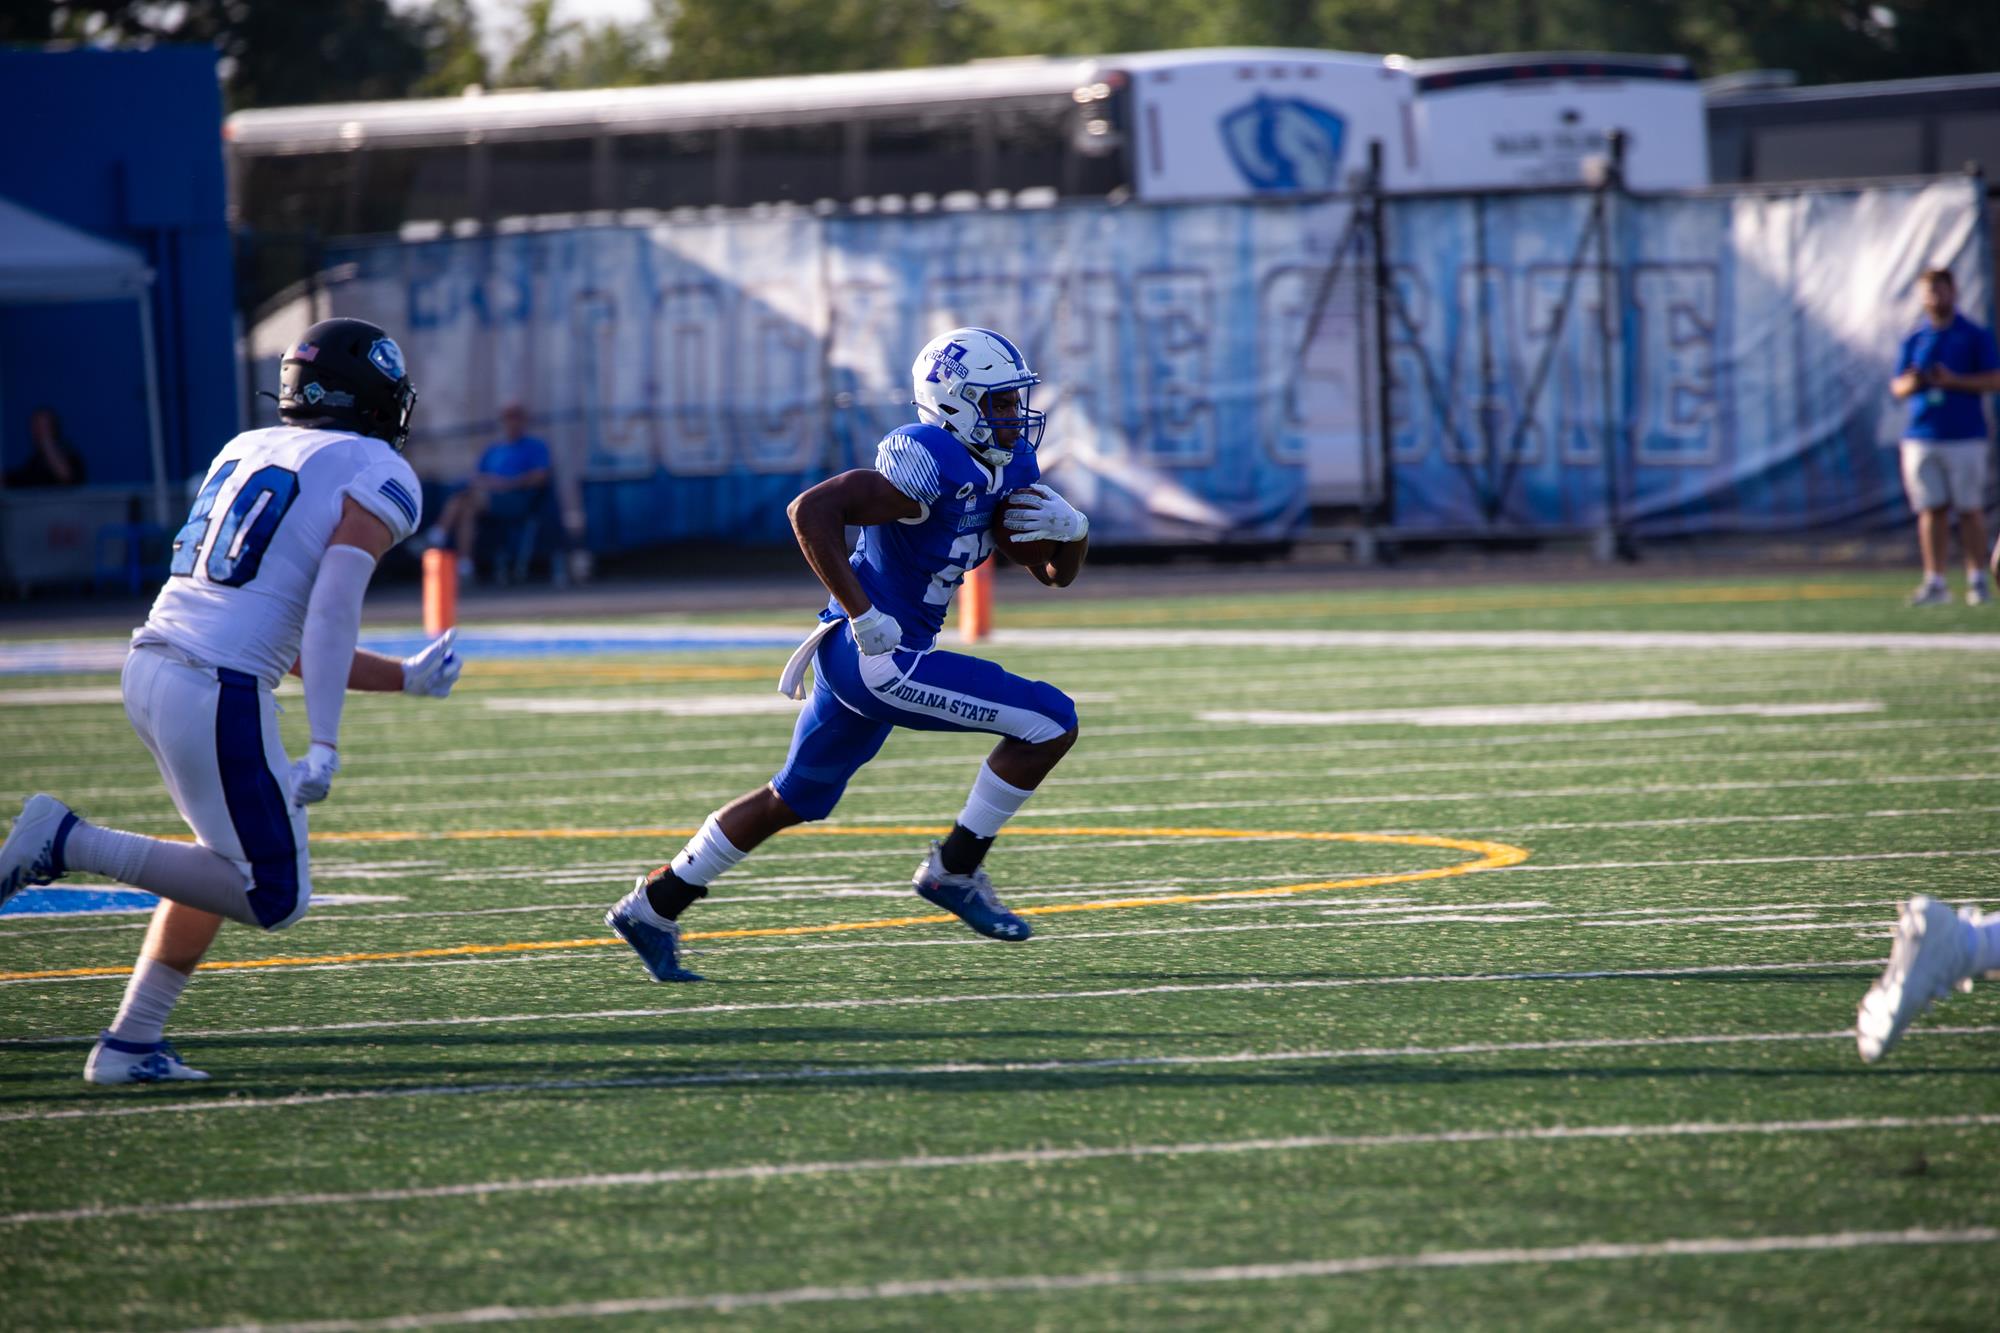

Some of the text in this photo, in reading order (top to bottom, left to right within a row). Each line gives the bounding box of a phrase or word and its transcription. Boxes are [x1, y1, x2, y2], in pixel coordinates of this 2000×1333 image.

[928, 350, 968, 379] SYCAMORES
[171, 459, 300, 588] 40
[874, 677, 999, 722] INDIANA STATE
